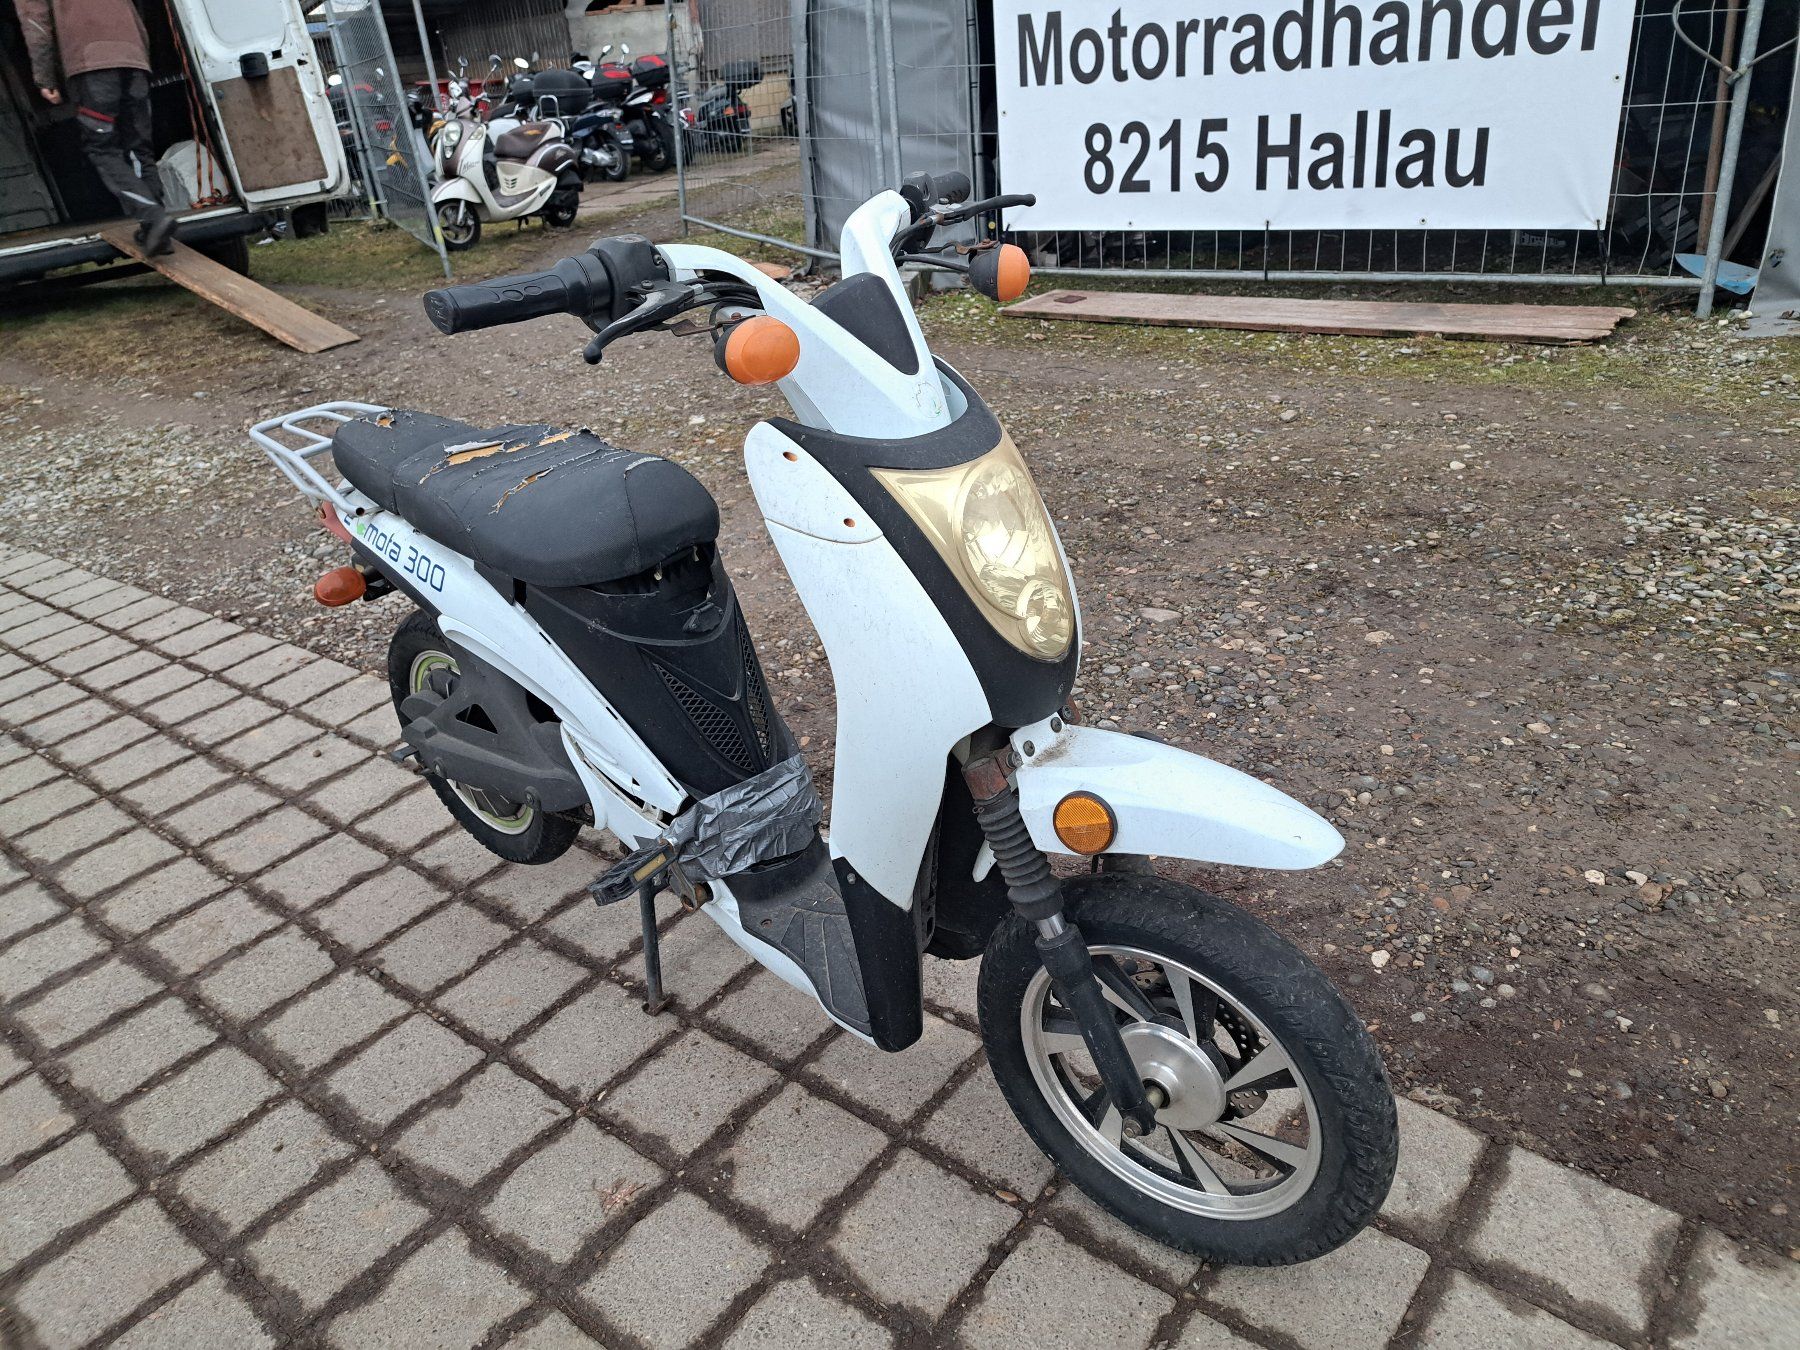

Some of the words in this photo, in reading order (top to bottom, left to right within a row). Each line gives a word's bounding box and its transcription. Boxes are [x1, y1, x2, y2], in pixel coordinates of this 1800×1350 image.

[1017, 0, 1601, 88] Motorradhandel
[1083, 117, 1230, 195] 8215
[1255, 108, 1491, 191] Hallau
[403, 545, 446, 593] 300
